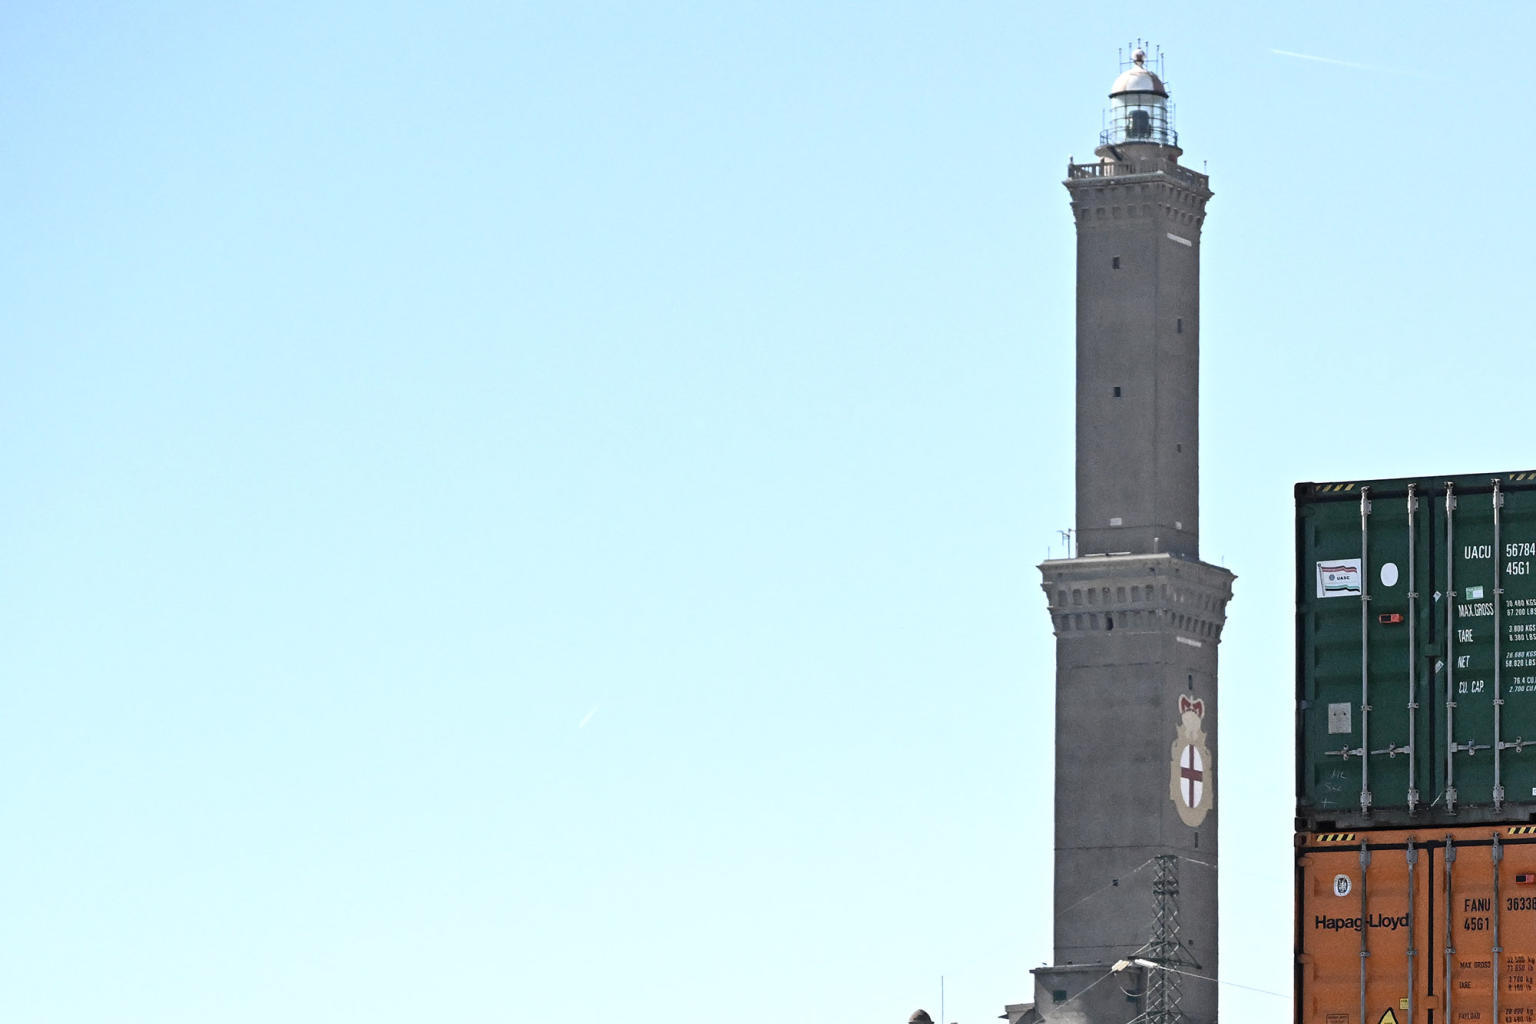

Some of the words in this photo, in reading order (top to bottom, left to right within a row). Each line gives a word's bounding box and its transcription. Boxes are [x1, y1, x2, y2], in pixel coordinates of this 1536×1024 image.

[1464, 545, 1492, 560] UACU
[1506, 561, 1530, 575] 45G1
[1458, 629, 1474, 643] TARE
[1525, 624, 1536, 632] KGS
[1526, 633, 1536, 641] LBS
[1457, 655, 1470, 669] NET
[1464, 898, 1491, 912] FANU
[1315, 913, 1411, 931] Hapag-Lloyd
[1464, 917, 1490, 931] 45G1
